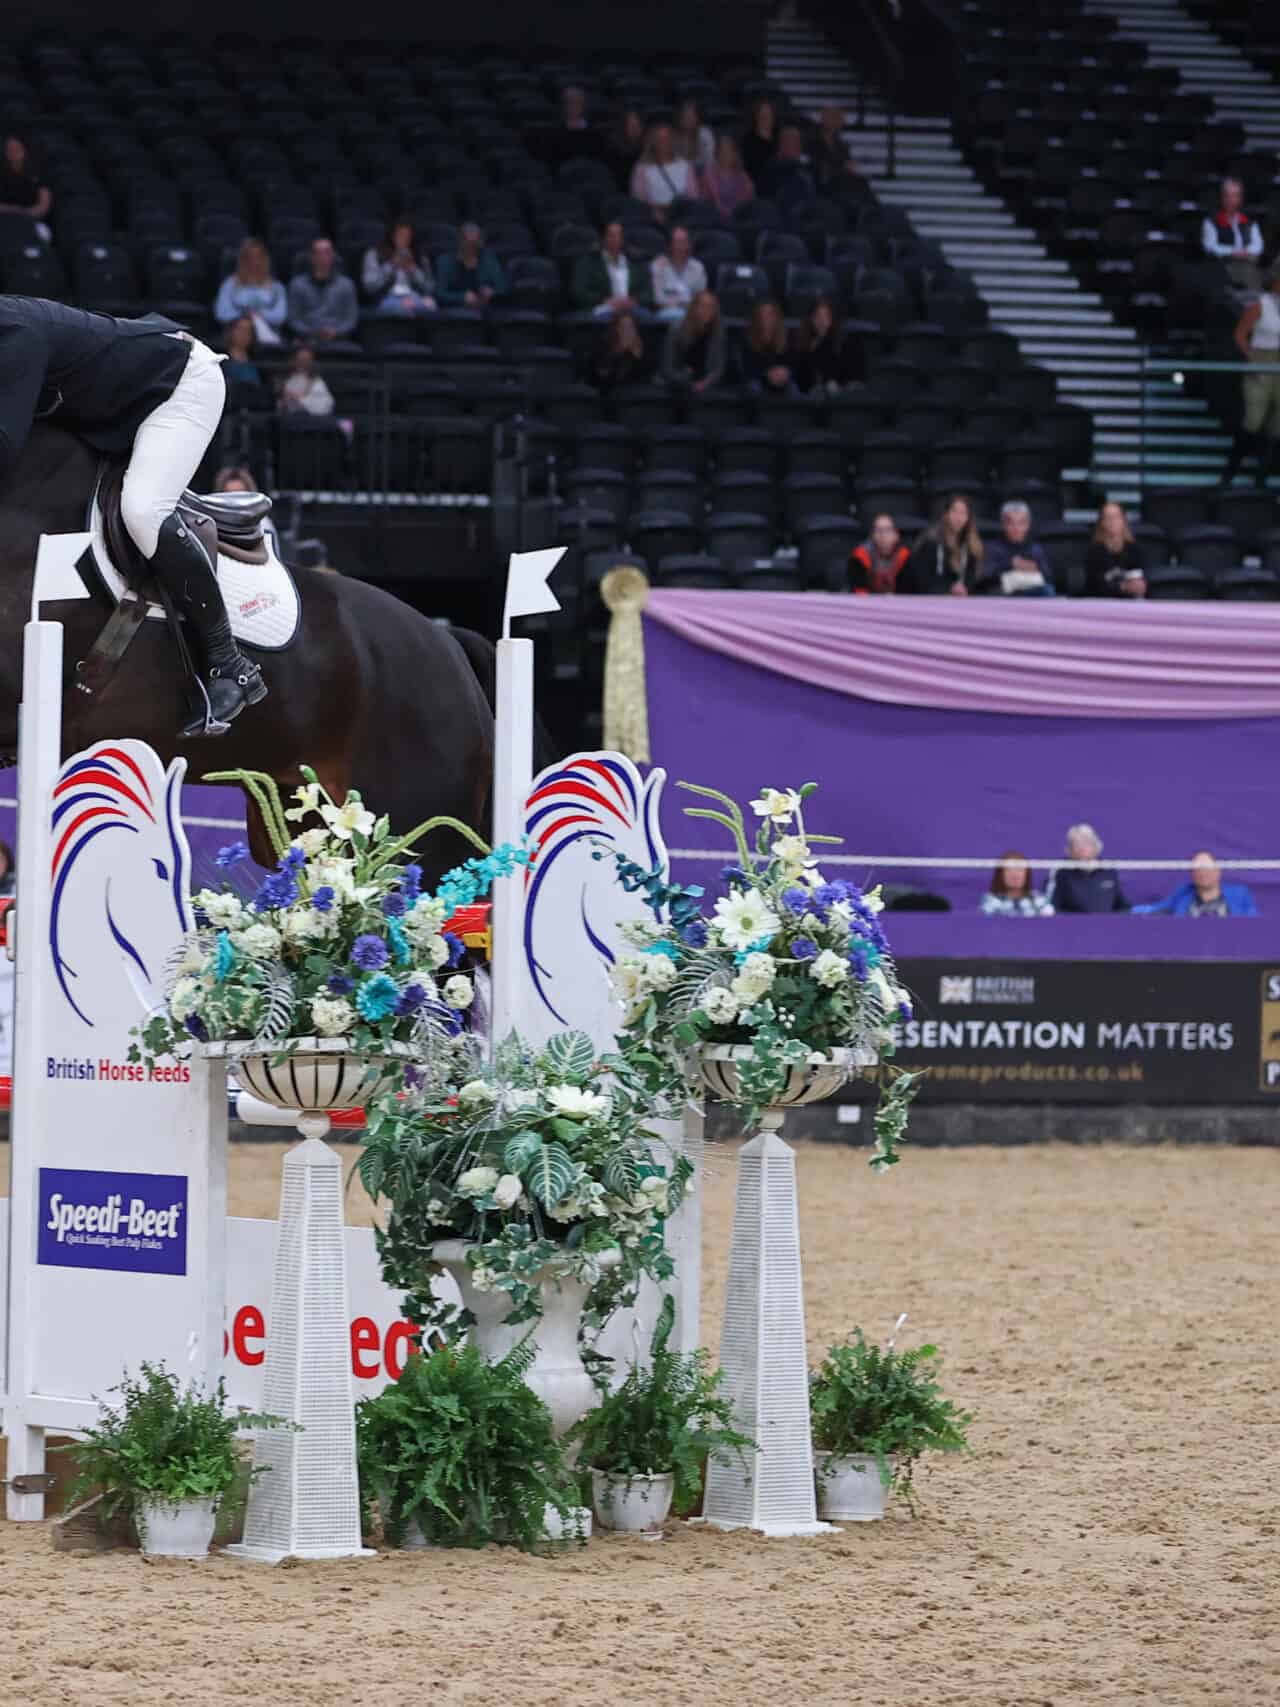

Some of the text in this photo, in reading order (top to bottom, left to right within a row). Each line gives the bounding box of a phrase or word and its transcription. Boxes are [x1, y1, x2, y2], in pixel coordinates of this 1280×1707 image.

[892, 1020, 1234, 1051] ESENTATION MATTERS
[47, 1057, 96, 1081] British
[98, 1058, 145, 1082] Horse
